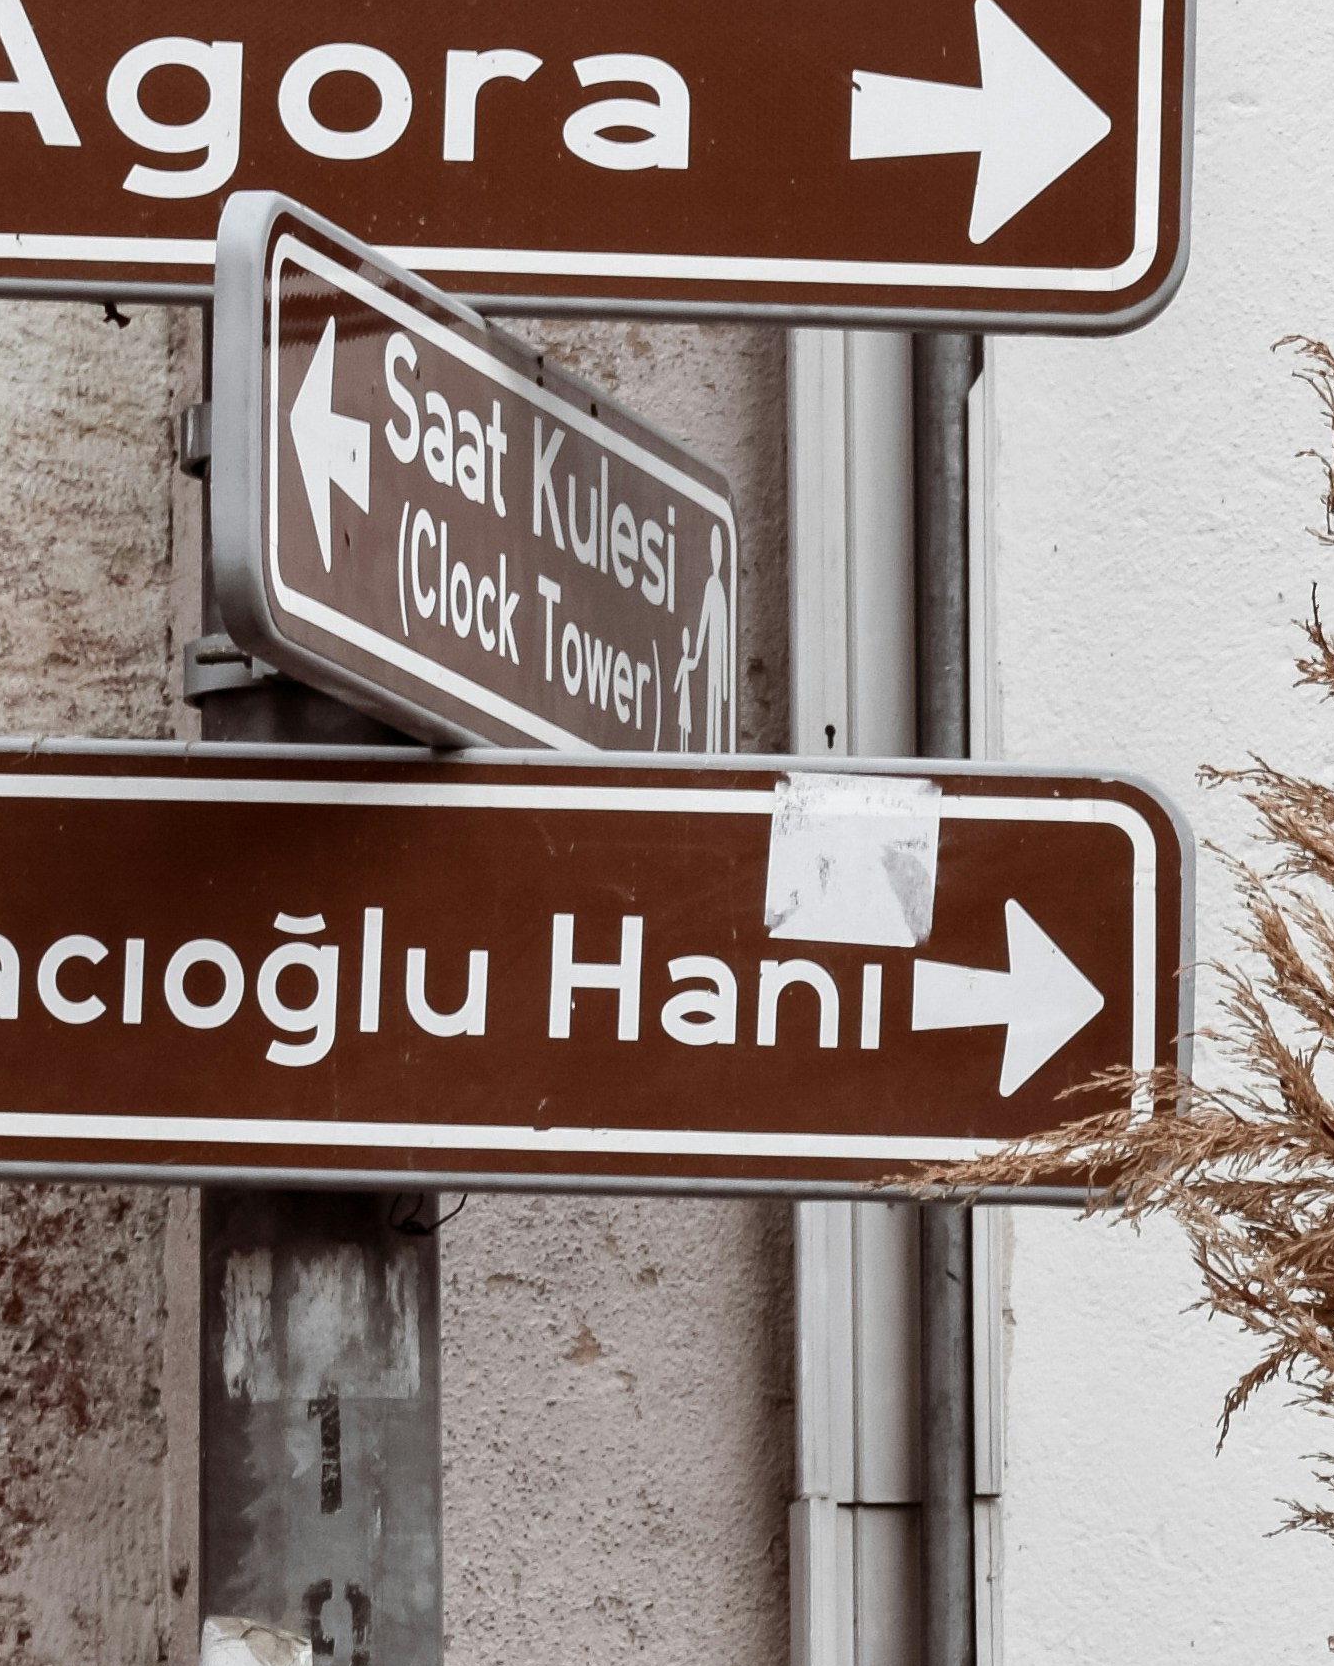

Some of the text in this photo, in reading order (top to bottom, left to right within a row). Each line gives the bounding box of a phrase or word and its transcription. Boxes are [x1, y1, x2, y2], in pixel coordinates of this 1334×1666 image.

[384, 331, 676, 614] Saat Kulesi
[397, 500, 662, 752] (Clock Tower)
[548, 912, 883, 1050] Hanı
